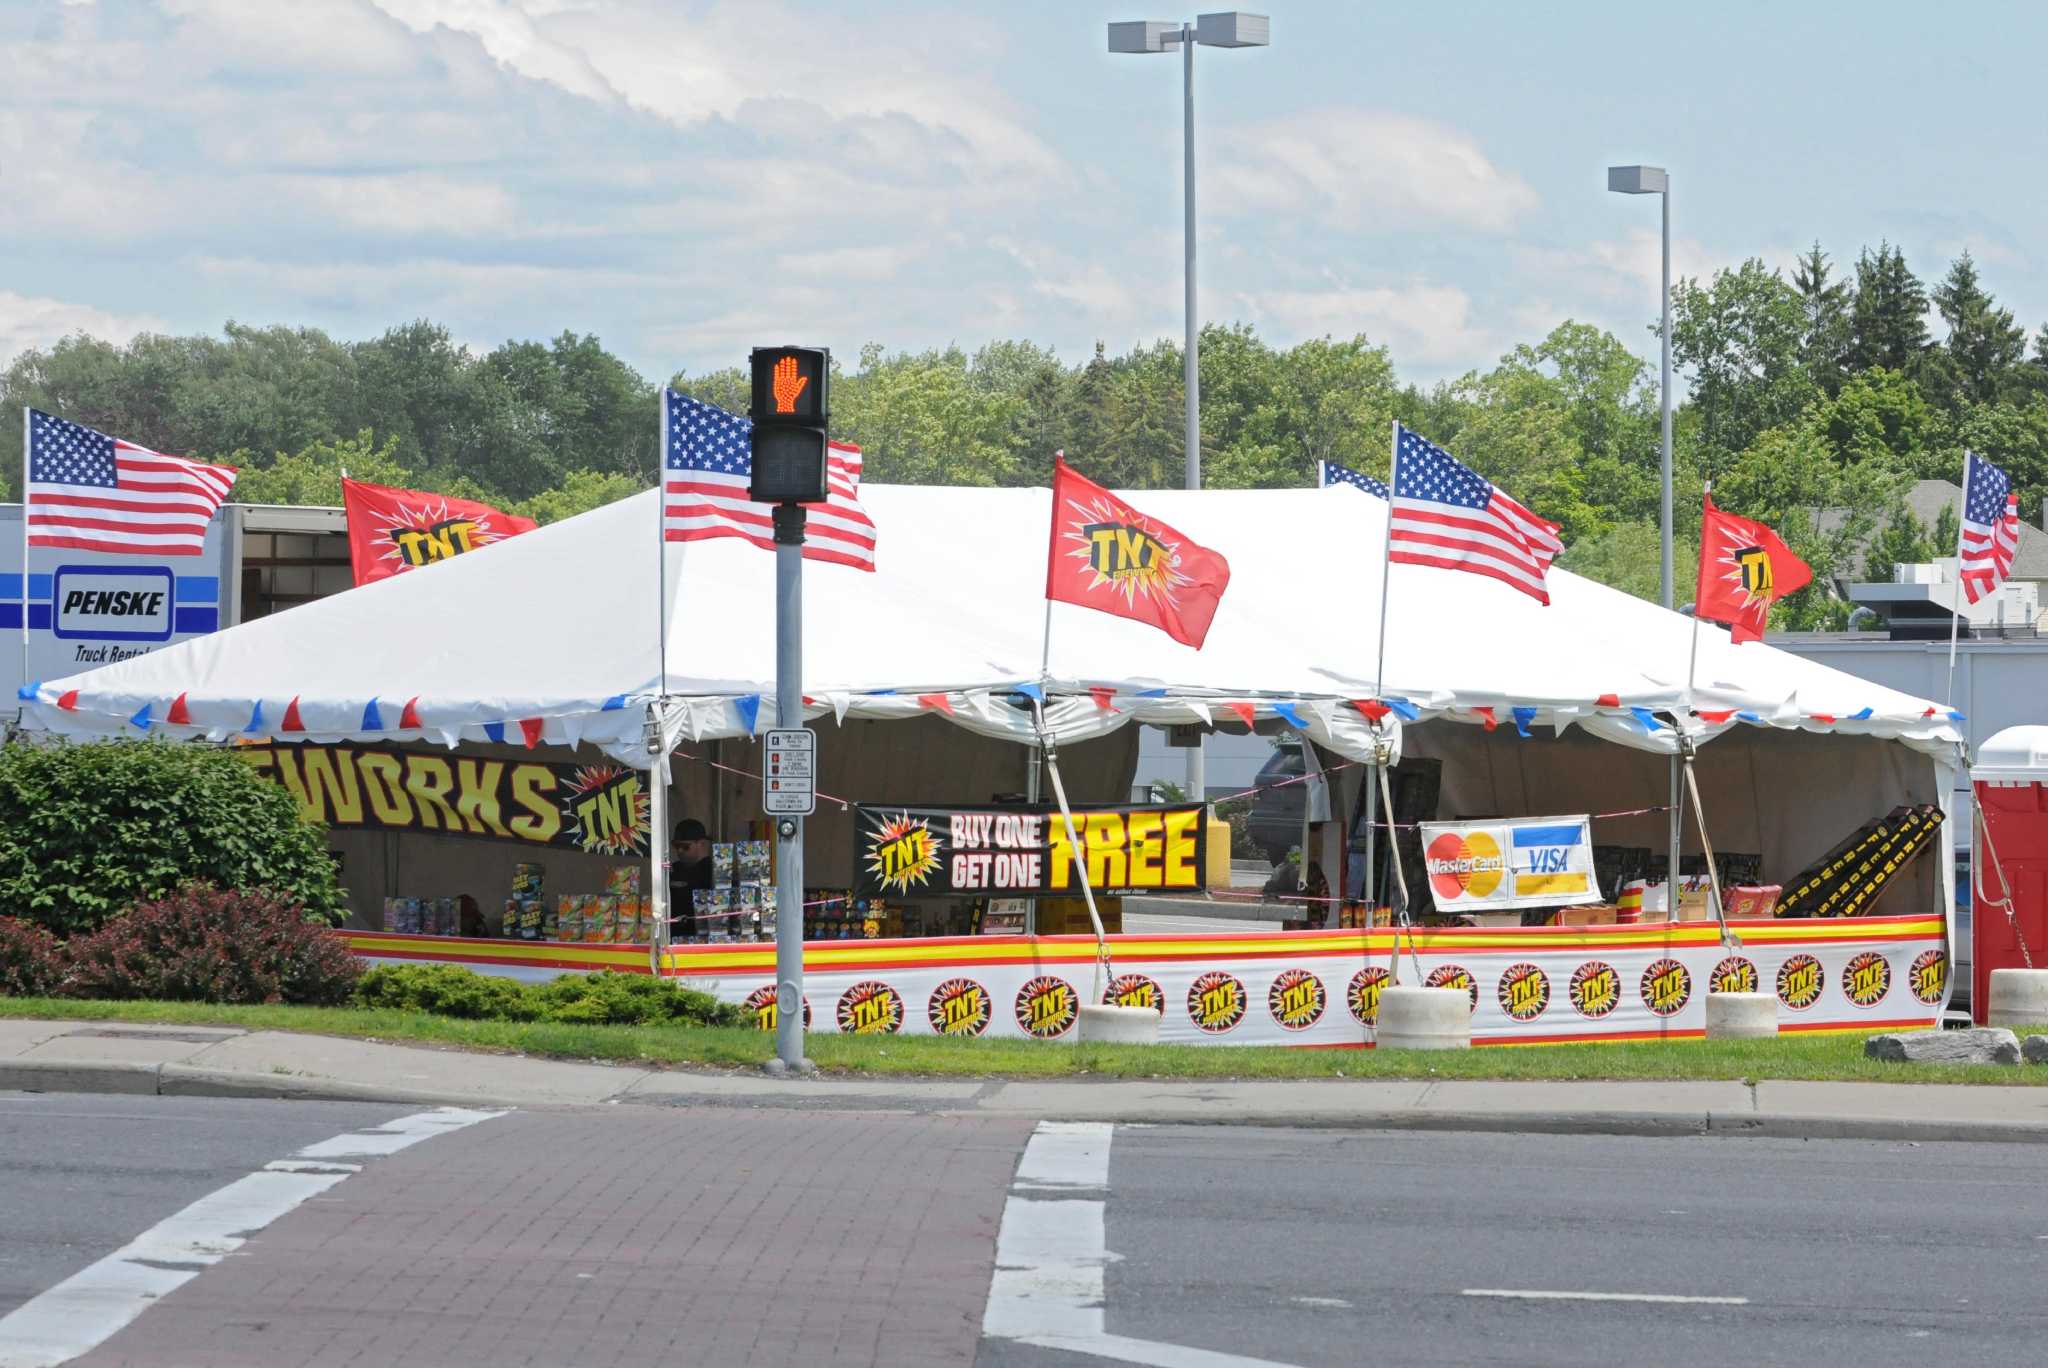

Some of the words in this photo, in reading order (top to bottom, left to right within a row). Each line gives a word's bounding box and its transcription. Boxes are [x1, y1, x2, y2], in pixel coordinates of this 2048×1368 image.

[399, 521, 479, 567] TNT
[1092, 528, 1171, 572] TNT
[1742, 551, 1773, 592] TN
[63, 590, 164, 616] PENSKE
[75, 644, 107, 662] Truck
[109, 645, 151, 662] Rent
[577, 776, 637, 844] TNT
[951, 815, 993, 848] BUY
[995, 815, 1042, 848] ONE
[881, 828, 926, 876] TNT
[1048, 811, 1200, 888] FREE
[1428, 855, 1502, 875] MasterCard
[1529, 848, 1568, 873] VISA
[952, 854, 992, 888] GET
[994, 854, 1042, 888] ONE
[1775, 833, 1879, 915] FIREWORKS
[1818, 822, 1912, 914] FIREWORKS
[1844, 820, 1934, 915] FIREWORKS
[1511, 971, 1541, 1005] TNT
[1583, 970, 1611, 1002] TNT
[1653, 967, 1682, 999] TNT
[1789, 962, 1818, 993] TNT
[1855, 960, 1884, 990] TNT
[1921, 959, 1945, 988] TNT
[854, 991, 890, 1027] TNT
[945, 987, 979, 1024] TNT
[1032, 987, 1066, 1019] TNT
[1119, 984, 1152, 1007] TNT
[1203, 981, 1234, 1014] TNT
[1284, 978, 1314, 1012] TNT
